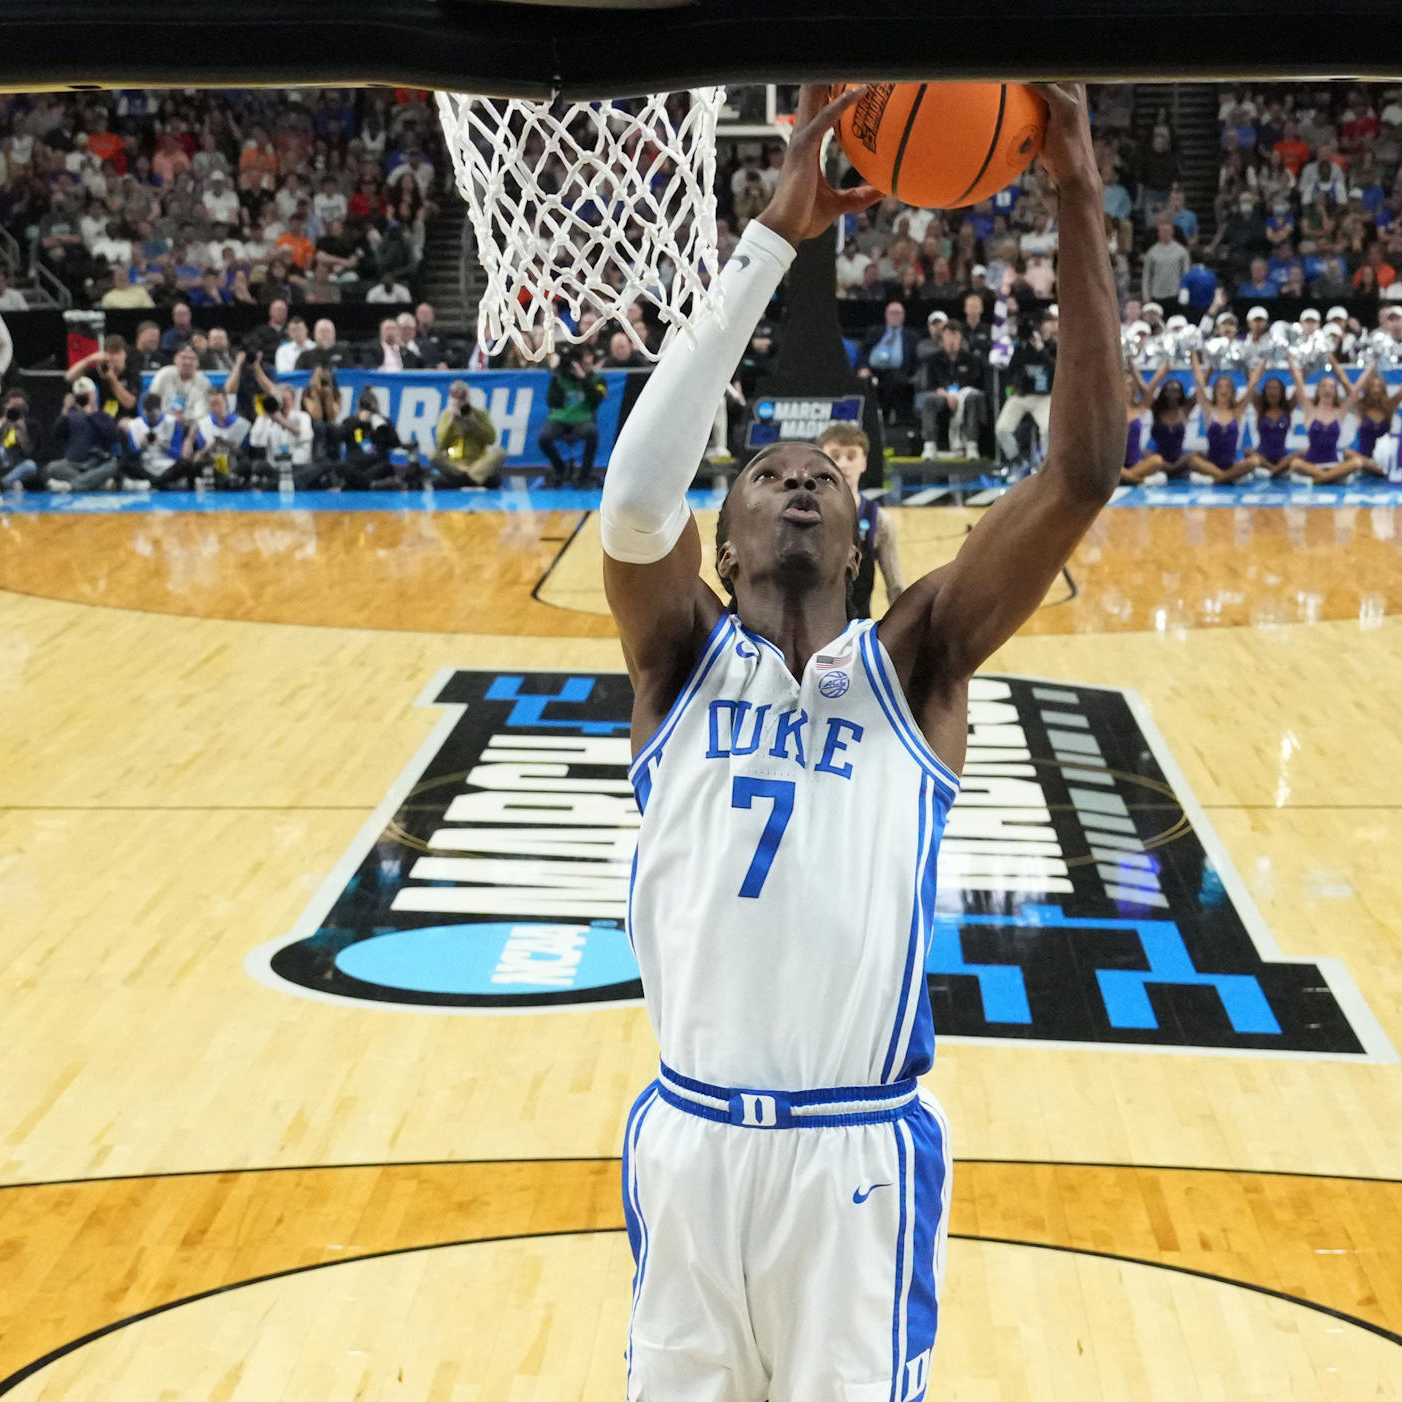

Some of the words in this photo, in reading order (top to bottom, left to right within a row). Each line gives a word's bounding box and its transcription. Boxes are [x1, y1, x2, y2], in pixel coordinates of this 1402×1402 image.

[705, 699, 865, 781] DUKE
[731, 775, 796, 899] 7
[491, 924, 591, 987] NCAA
[741, 1093, 778, 1126] D
